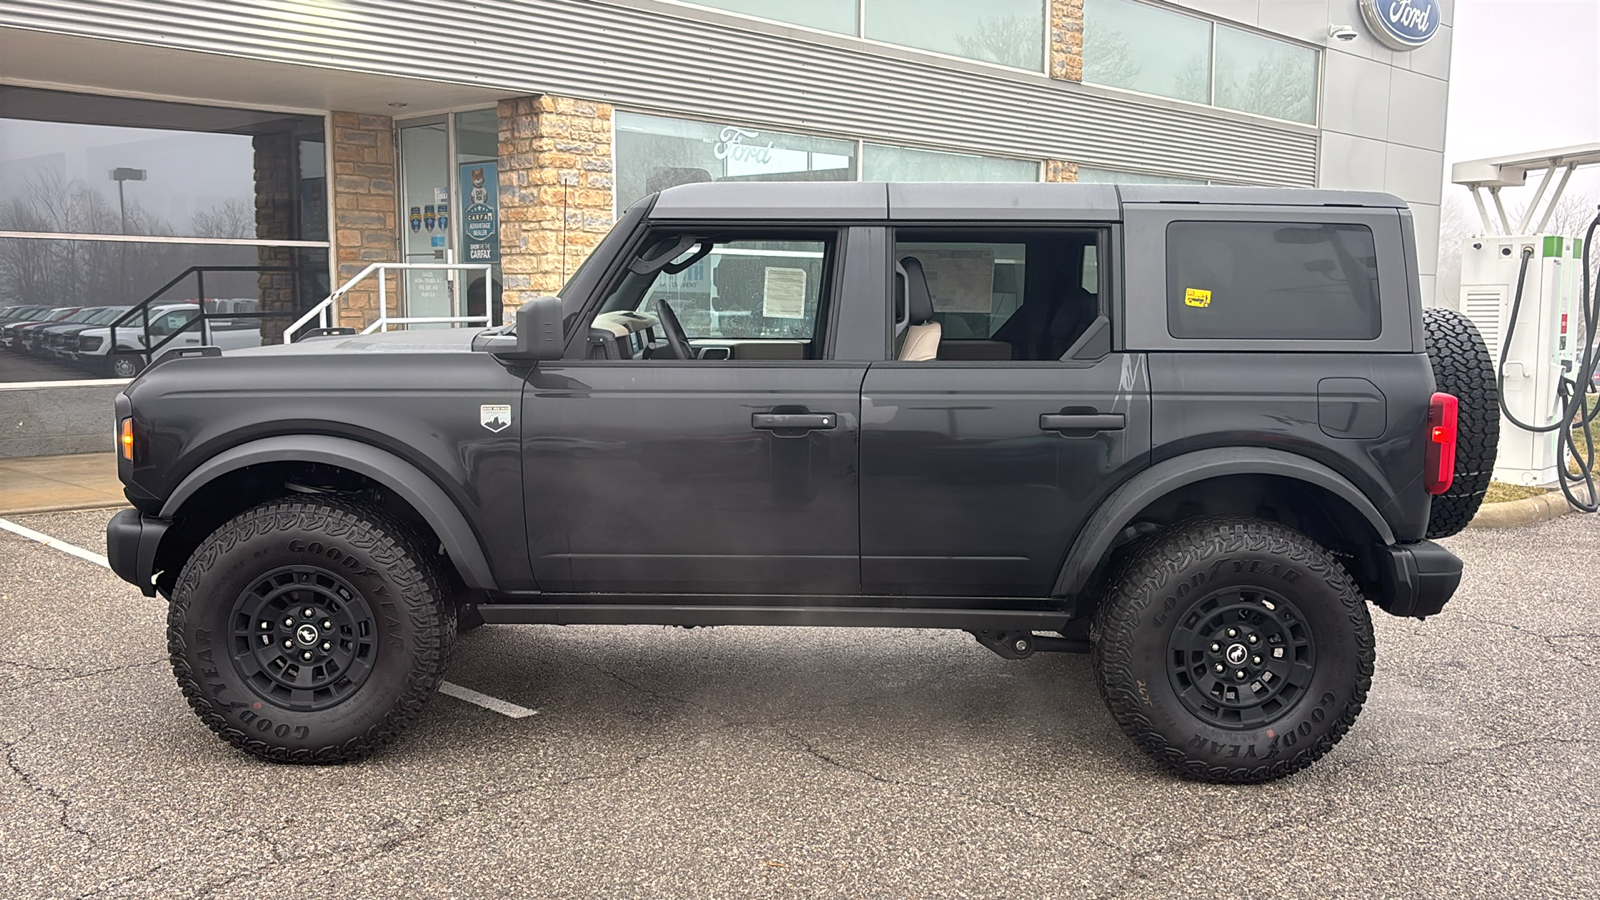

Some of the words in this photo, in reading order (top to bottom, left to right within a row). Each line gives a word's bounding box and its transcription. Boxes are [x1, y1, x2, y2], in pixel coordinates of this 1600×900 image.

[1389, 0, 1432, 33] Ford
[713, 126, 774, 165] Ford
[467, 212, 493, 222] CARFAX
[469, 222, 491, 230] ADVANTAGE
[470, 250, 492, 259] CARFAX
